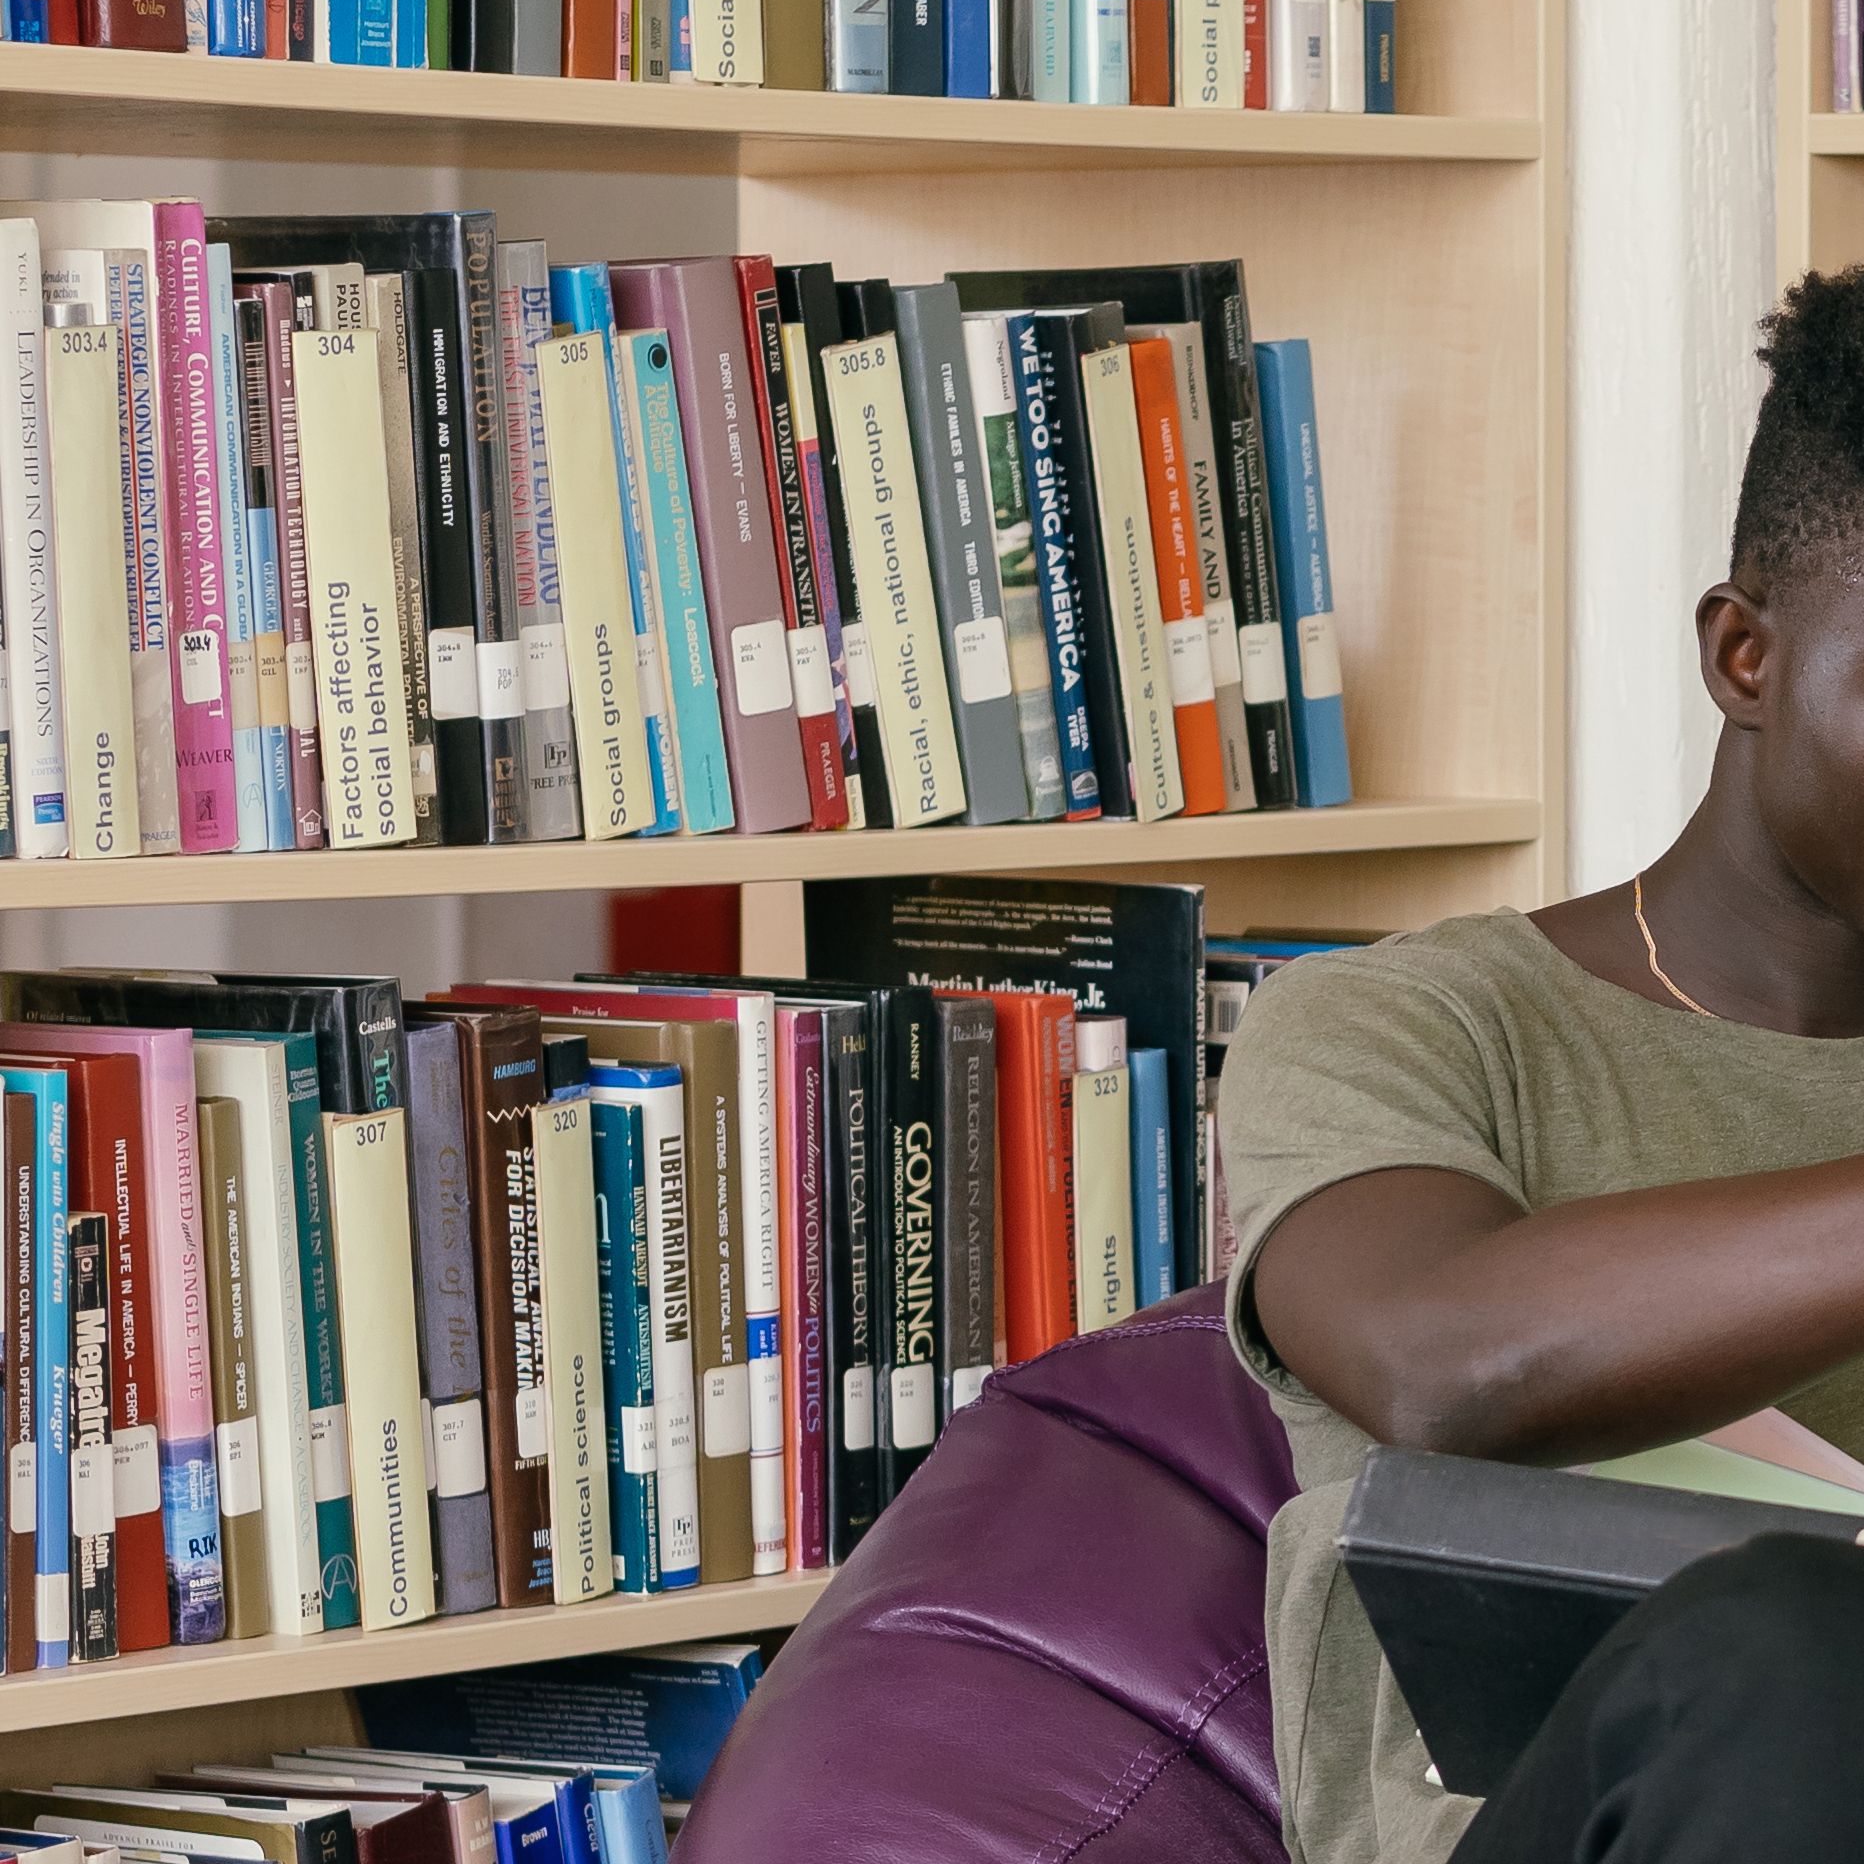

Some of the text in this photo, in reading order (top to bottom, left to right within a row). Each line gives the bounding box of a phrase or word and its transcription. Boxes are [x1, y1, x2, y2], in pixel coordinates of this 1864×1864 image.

[1202, 19, 1219, 102] Social
[60, 331, 108, 355] 303.4
[318, 334, 355, 356] 304
[560, 343, 589, 364] 305
[839, 349, 886, 375] 305.8
[432, 327, 454, 528] IMMIGRATION AND ETHNICITY
[1020, 325, 1083, 694] WE TOO SING AMERICA
[862, 403, 938, 814] Racial, ethic, national groups
[1122, 517, 1169, 810] Culture & institutions
[326, 581, 366, 841] Factors affecting
[362, 601, 397, 836] social behavior
[593, 624, 627, 827] Social groups
[94, 731, 116, 852] Change
[175, 746, 233, 769] WEAVER
[358, 1017, 397, 1036] Castells
[909, 1023, 920, 1082] RANNEY
[493, 1058, 536, 1081] HAMBURG
[1093, 1076, 1119, 1097] 323
[355, 1121, 388, 1145] 307
[553, 1109, 578, 1133] 320
[175, 1103, 196, 1224] MARRIED
[659, 1135, 690, 1344] LIBERTARIANISM
[906, 1121, 934, 1365] GOVERNING
[1105, 1235, 1119, 1315] rights
[184, 1255, 201, 1338] SINGLE
[189, 1344, 205, 1401] LIFE
[572, 1354, 595, 1594] Political science
[188, 1535, 218, 1559] RIK
[380, 1418, 408, 1618] Communities
[521, 1827, 549, 1847] Brown
